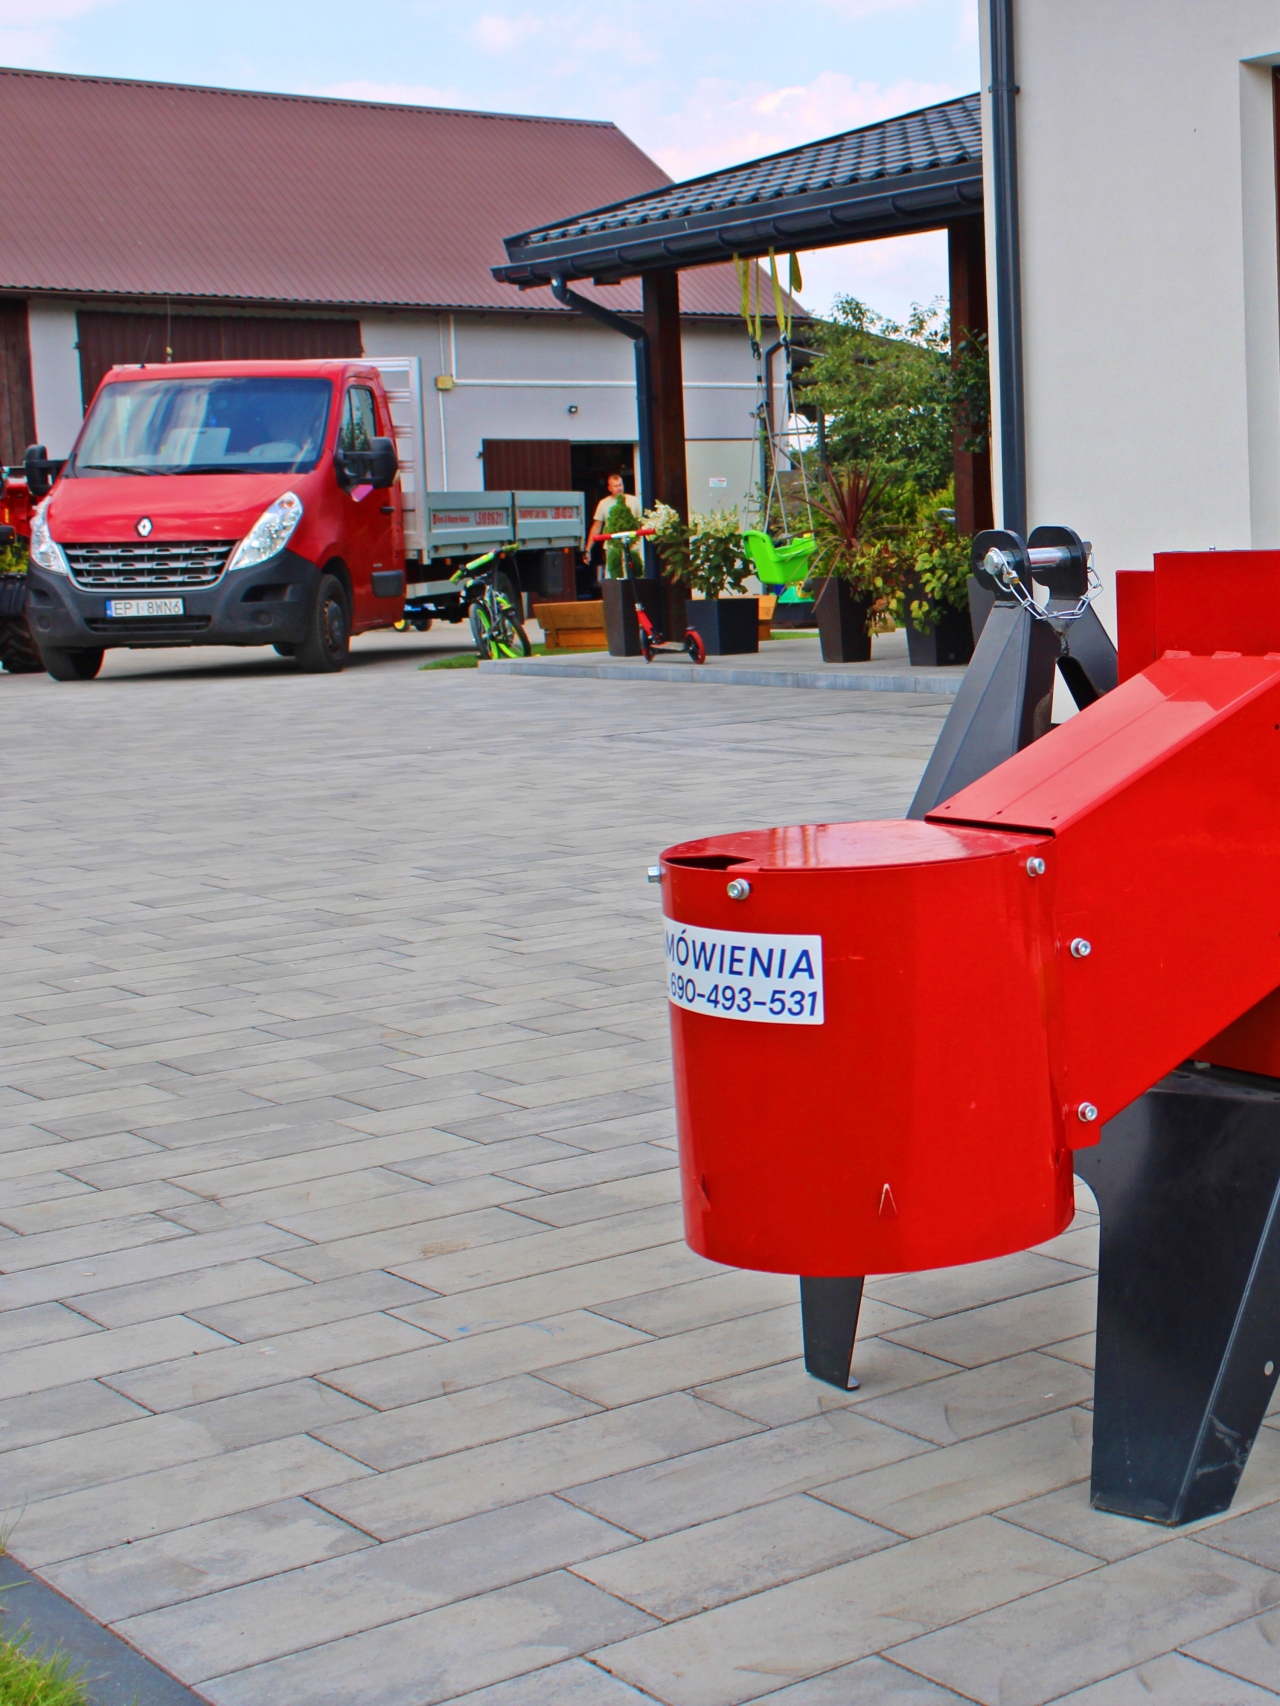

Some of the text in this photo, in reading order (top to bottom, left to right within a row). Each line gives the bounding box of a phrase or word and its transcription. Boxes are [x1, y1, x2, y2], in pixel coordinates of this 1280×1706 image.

[147, 601, 181, 615] 8WN6
[665, 928, 816, 980] MÓWIENIA
[671, 972, 818, 1017] 690-493-531
